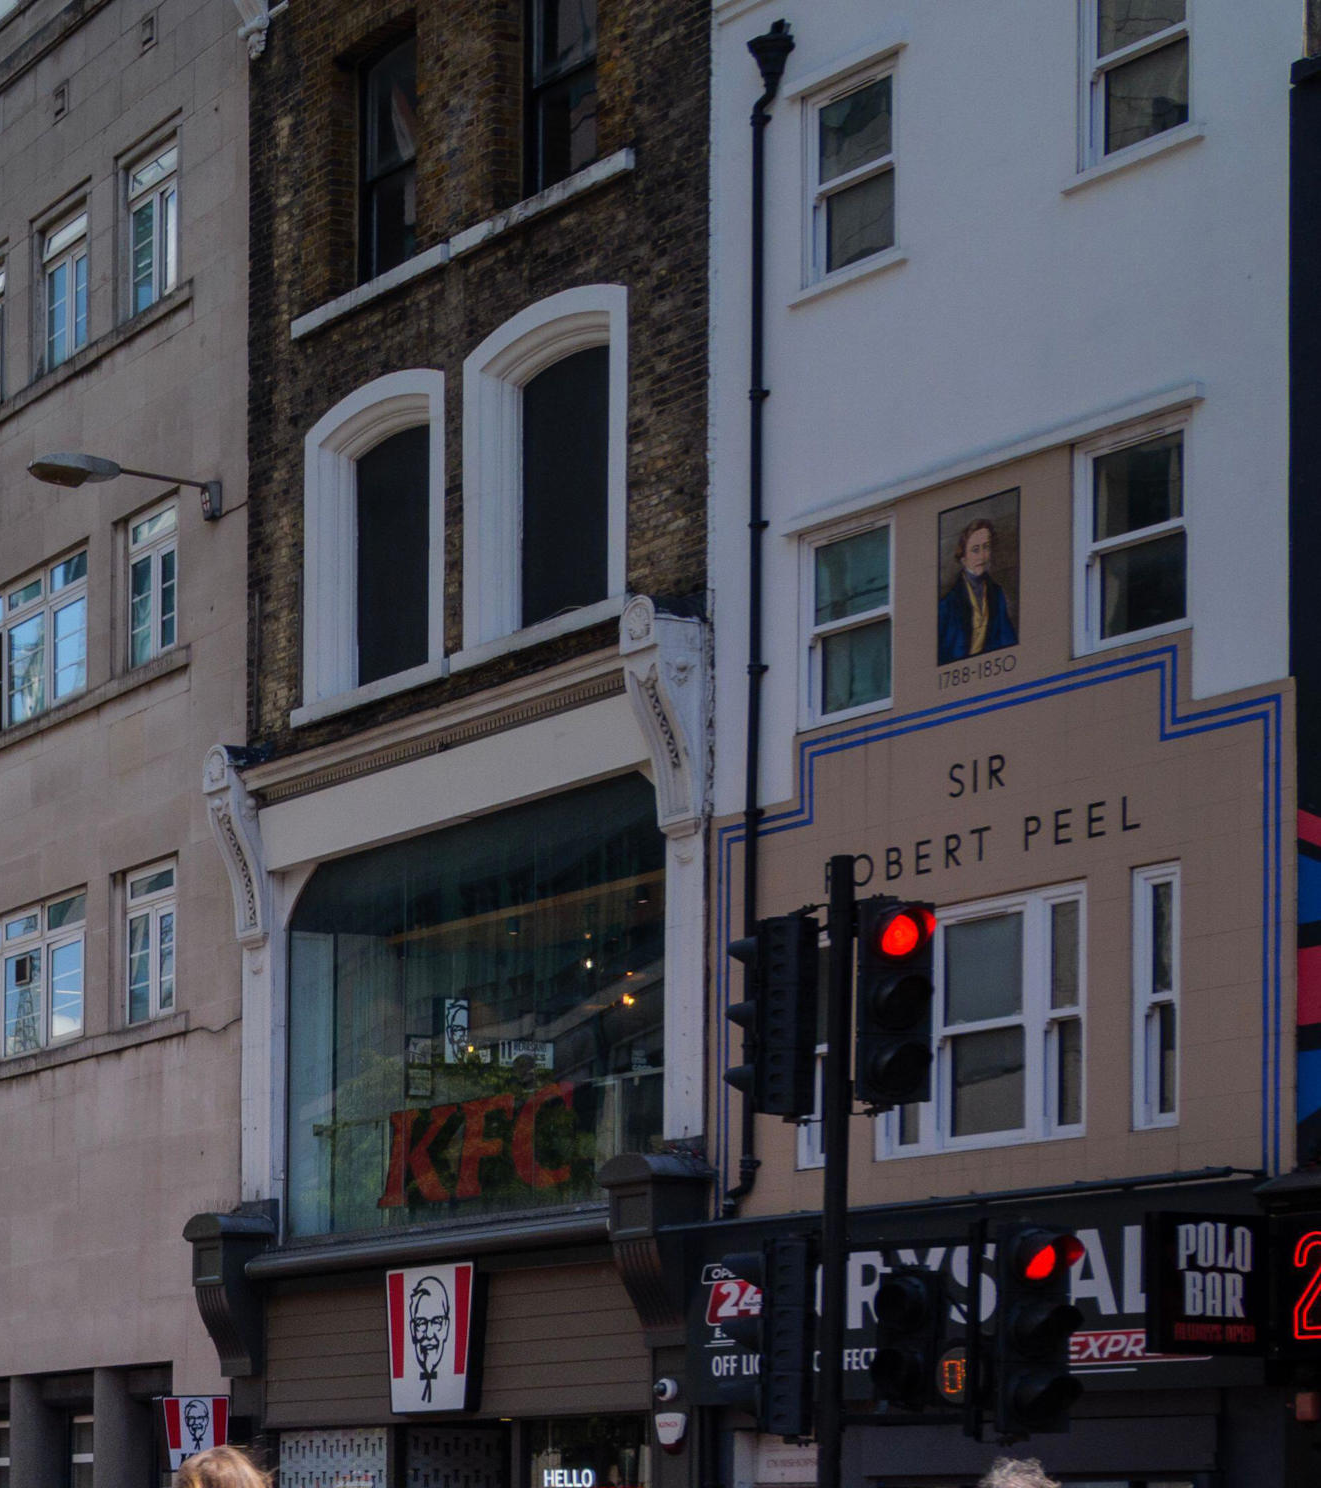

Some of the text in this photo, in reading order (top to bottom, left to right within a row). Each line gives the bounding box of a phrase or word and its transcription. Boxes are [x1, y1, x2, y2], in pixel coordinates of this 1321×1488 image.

[936, 655, 1017, 690] 1788-1850
[948, 754, 1007, 798] SIR
[1024, 796, 1141, 852] PEEL
[378, 1082, 574, 1207] KFC
[1177, 1221, 1253, 1273] POLO
[711, 1267, 737, 1280] OP
[814, 1225, 1147, 1331] RSAL
[717, 1282, 763, 1317] 24
[1184, 1270, 1245, 1319] BAR
[1069, 1333, 1146, 1361] EXPR
[712, 1355, 738, 1376] OFF
[943, 1360, 966, 1393] 0
[544, 1469, 593, 1488] HELLO
